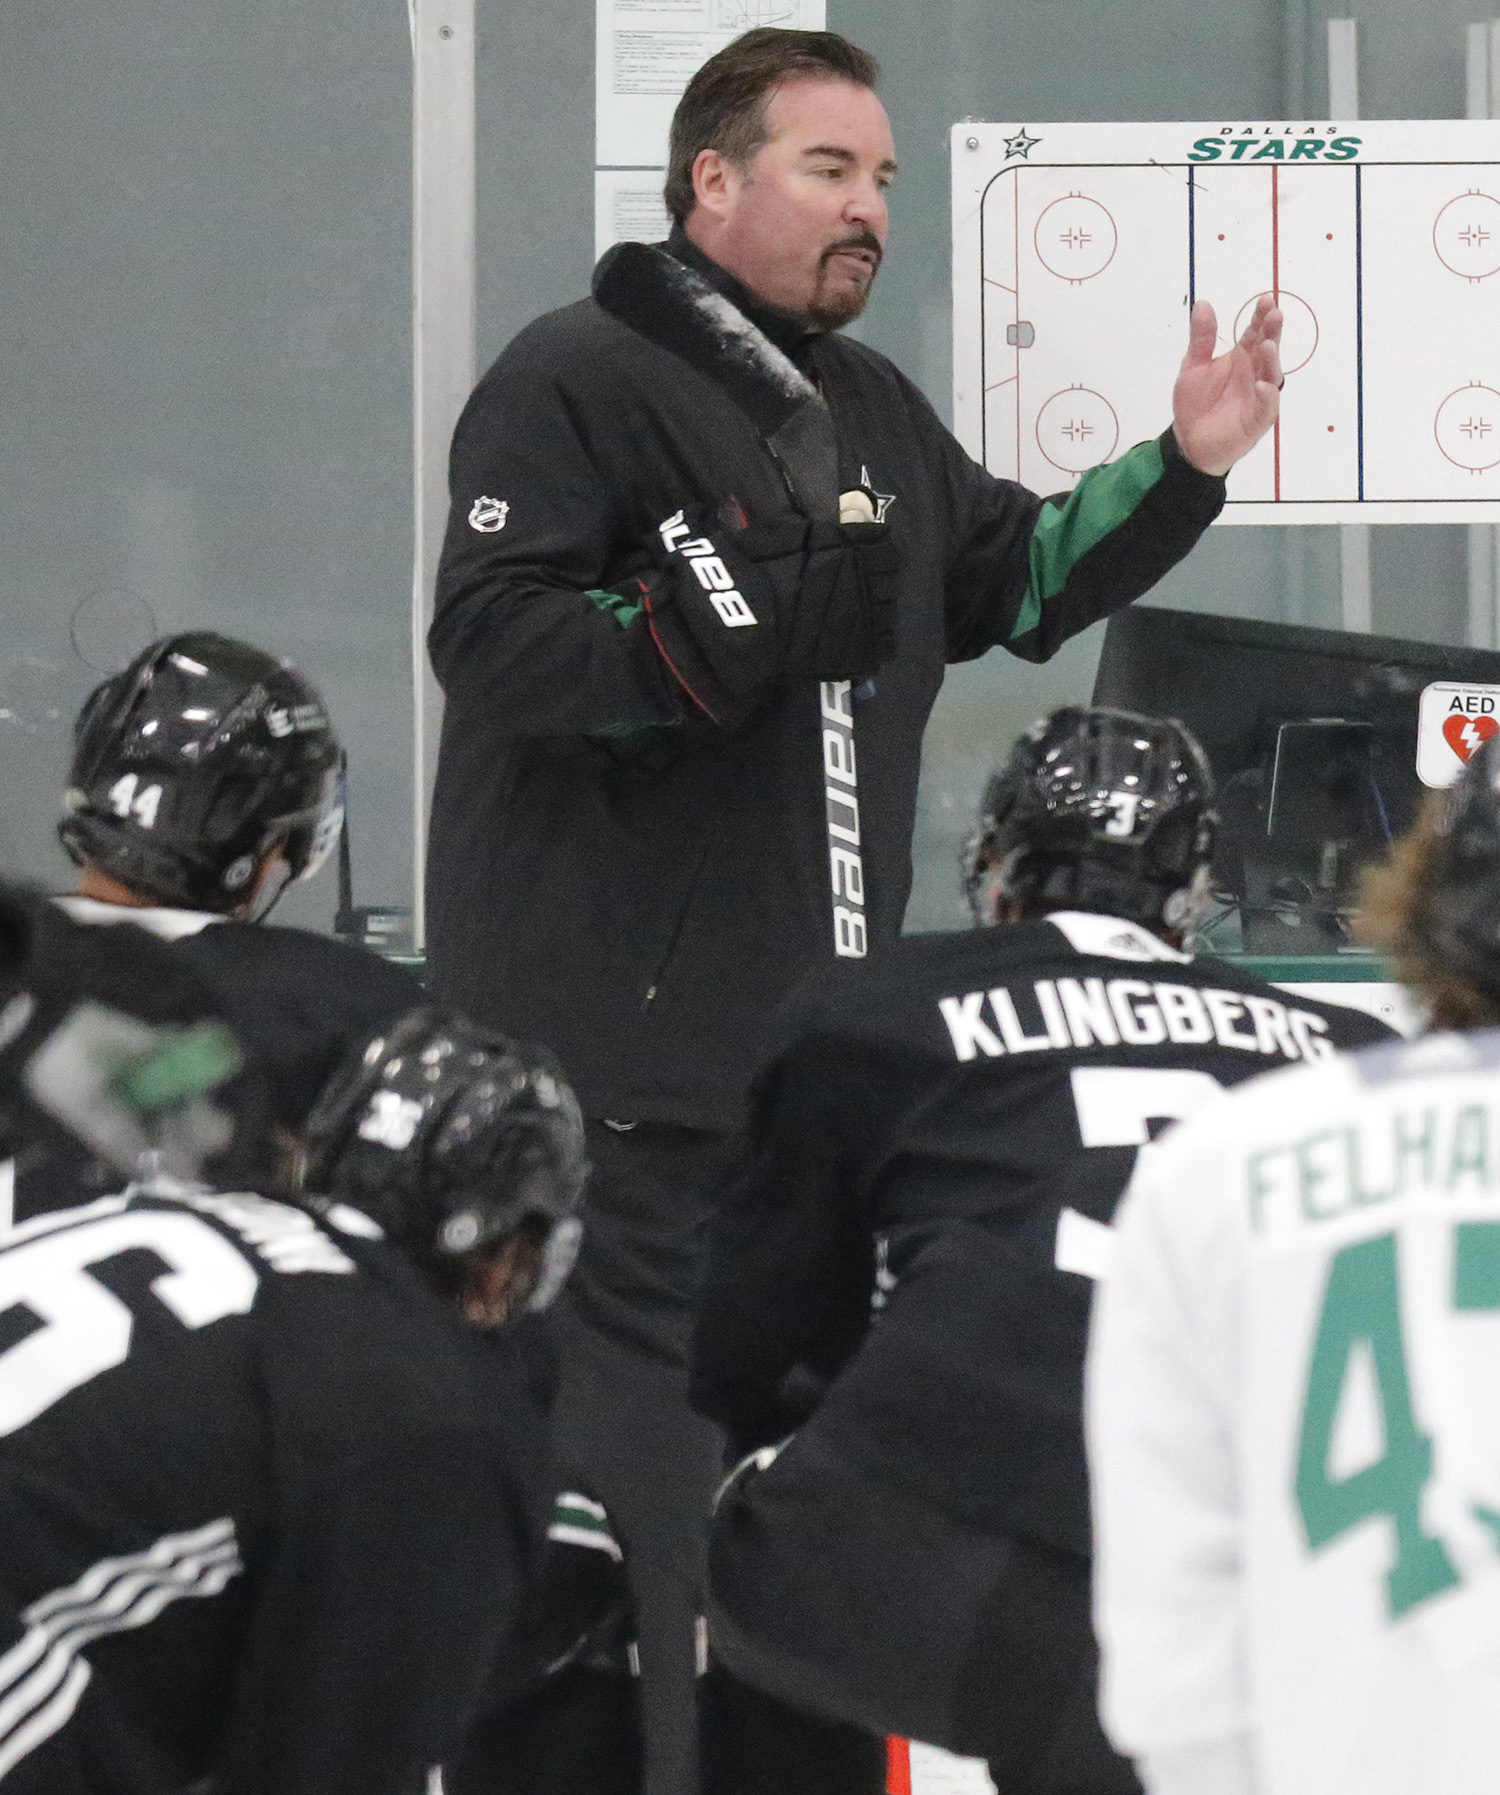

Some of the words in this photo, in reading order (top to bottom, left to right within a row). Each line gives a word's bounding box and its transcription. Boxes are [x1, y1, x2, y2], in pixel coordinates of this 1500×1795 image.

[1219, 127, 1338, 135] DALLAS
[1187, 137, 1362, 161] STARS
[1449, 695, 1495, 714] AED
[107, 772, 163, 830] 44
[1103, 793, 1137, 837] 3
[938, 977, 1333, 1063] KLINGBERG
